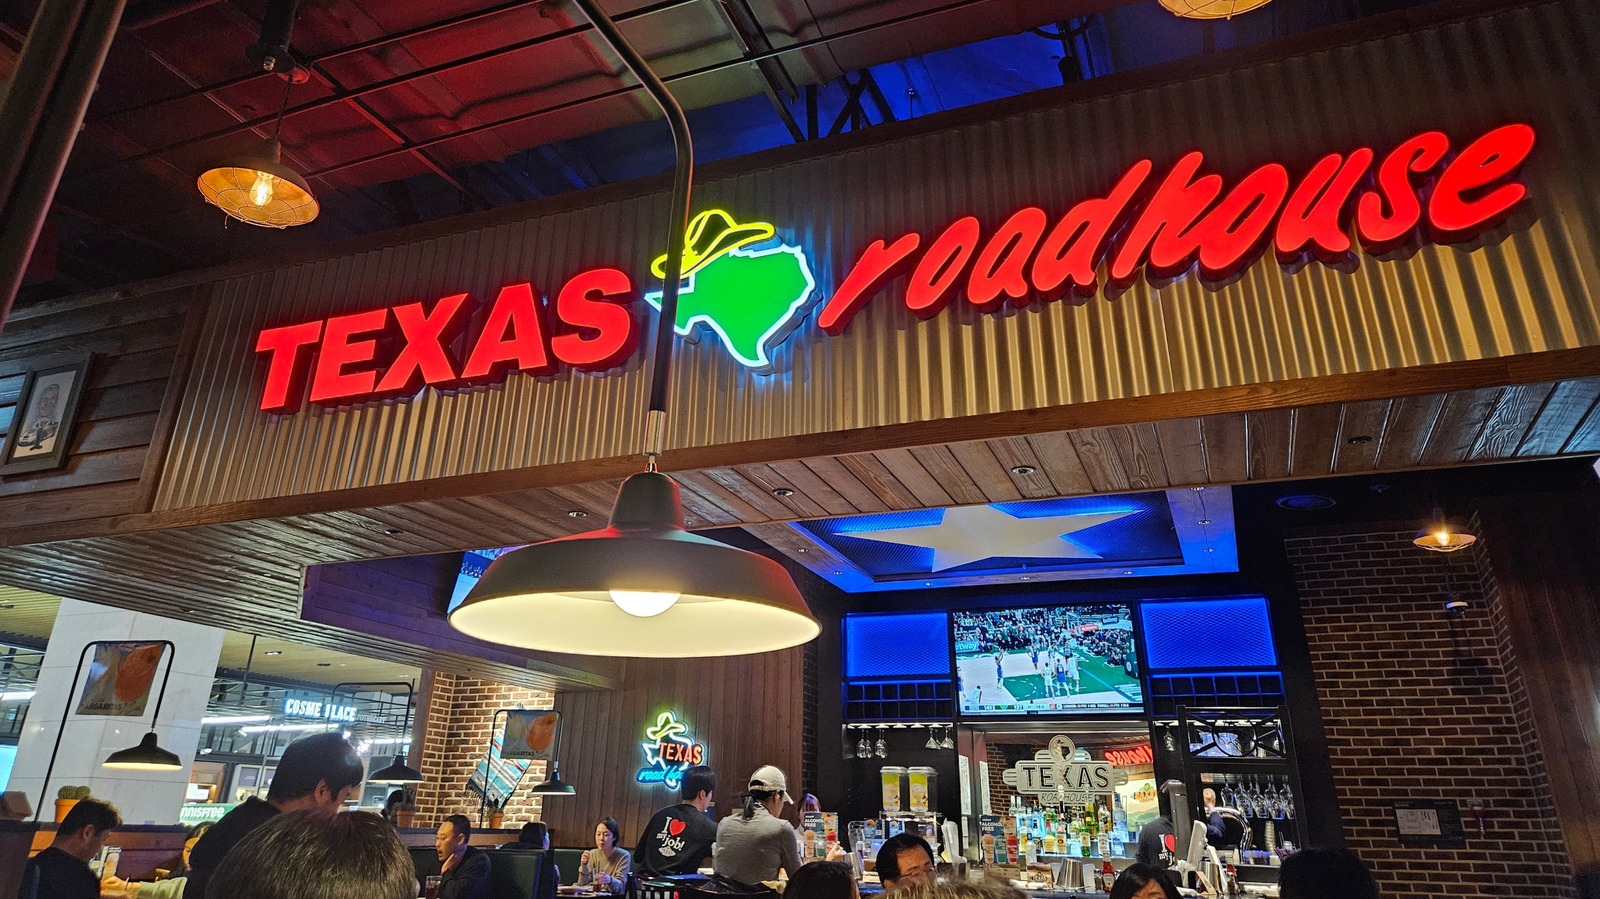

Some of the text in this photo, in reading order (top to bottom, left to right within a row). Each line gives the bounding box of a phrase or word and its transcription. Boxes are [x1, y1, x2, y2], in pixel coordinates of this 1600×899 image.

[254, 123, 1536, 411] TEXAS roadhouse
[79, 702, 122, 711] ARGARITAS
[285, 698, 322, 717] COSME
[659, 742, 702, 765] TEXAS
[638, 765, 684, 781] roadho
[1021, 766, 1110, 789] TEXAS
[1041, 792, 1094, 802] ROAHOUSE
[661, 816, 672, 833] I
[661, 834, 686, 852] job!
